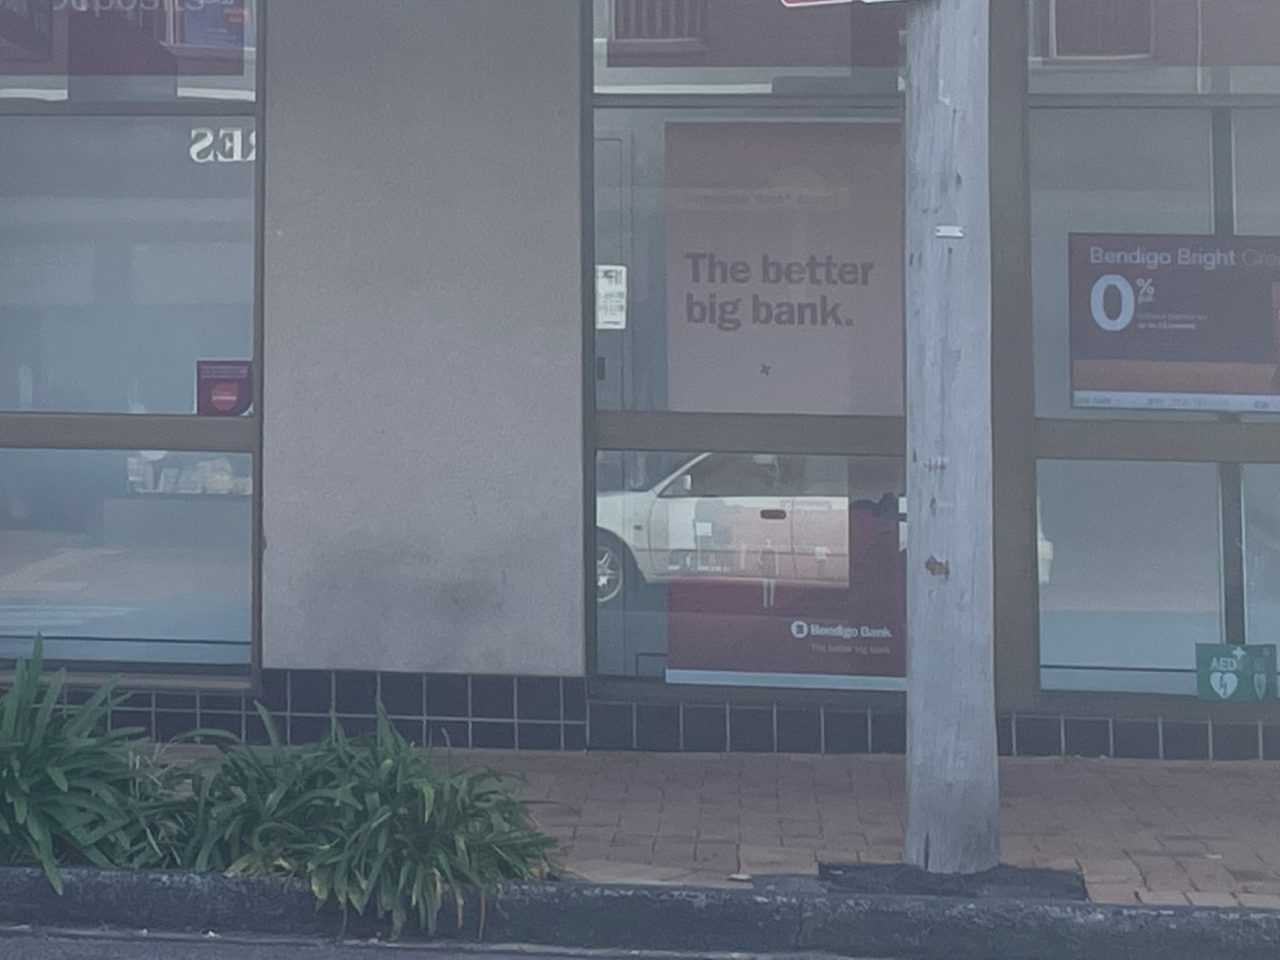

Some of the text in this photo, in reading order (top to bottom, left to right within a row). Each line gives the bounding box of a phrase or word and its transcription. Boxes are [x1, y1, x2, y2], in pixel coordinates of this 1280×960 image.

[685, 252, 874, 286] The better
[1089, 246, 1171, 269] Bendigo
[1177, 247, 1236, 270] Bright
[686, 293, 854, 331] big bank.
[810, 622, 891, 639] Bendigo Bank
[1209, 656, 1237, 672] AED
